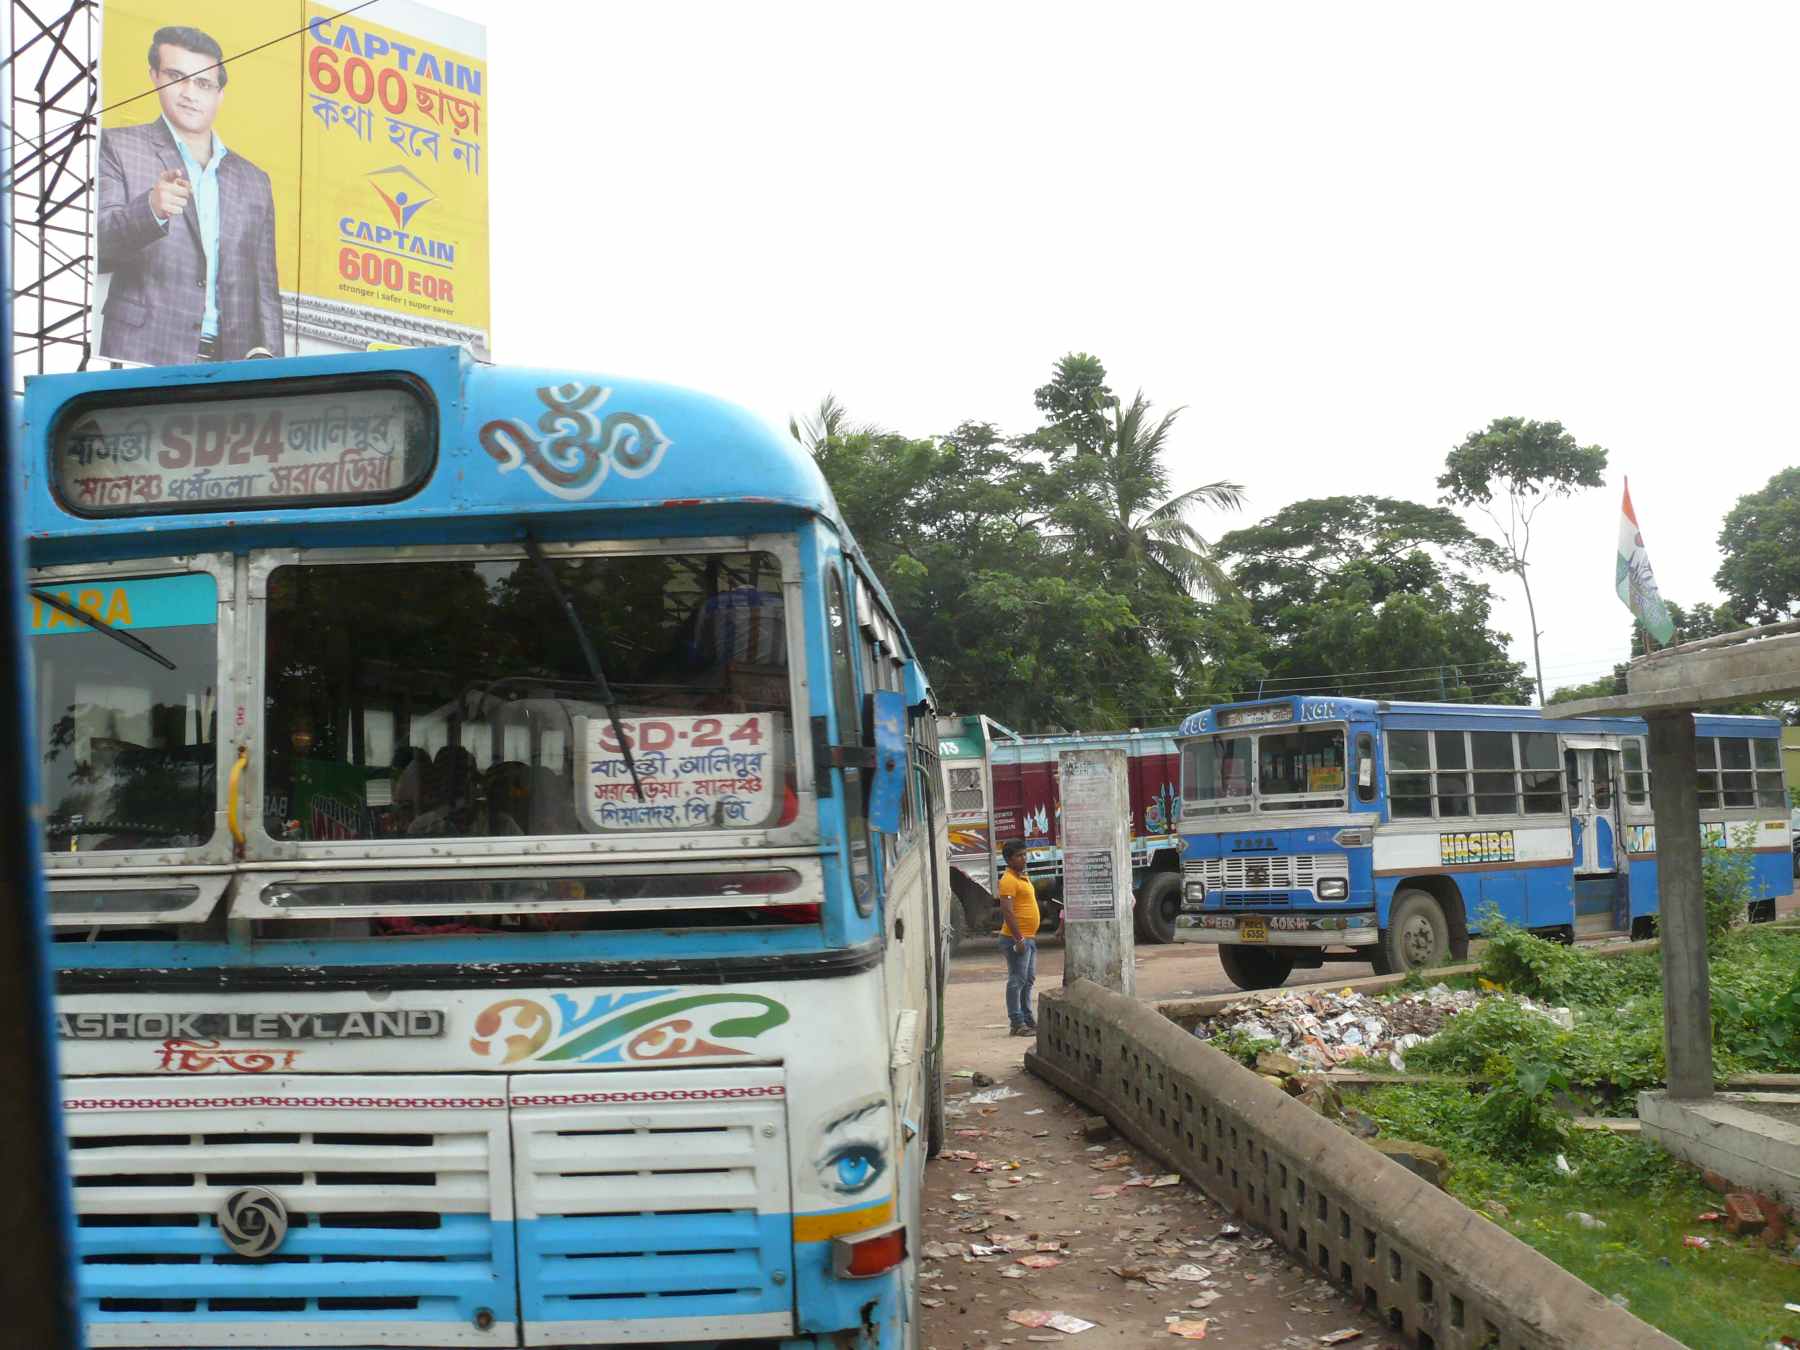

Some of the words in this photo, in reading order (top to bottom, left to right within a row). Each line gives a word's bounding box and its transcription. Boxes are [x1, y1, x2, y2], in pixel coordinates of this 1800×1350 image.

[309, 16, 481, 96] CAPTAIN
[309, 45, 407, 115] 600
[413, 82, 481, 137] ছাড়া
[308, 93, 374, 143] কথা
[384, 117, 440, 162] হবে
[450, 138, 481, 176] না
[339, 217, 454, 263] CAPTAIN
[339, 247, 403, 291] 600
[408, 271, 454, 302] EQR
[339, 284, 374, 298] stronger
[381, 292, 402, 304] safer
[408, 300, 431, 311] super
[679, 747, 767, 776] আলিপুর
[1200, 915, 1236, 929] SPEED
[228, 1010, 440, 1039] LEYLAND
